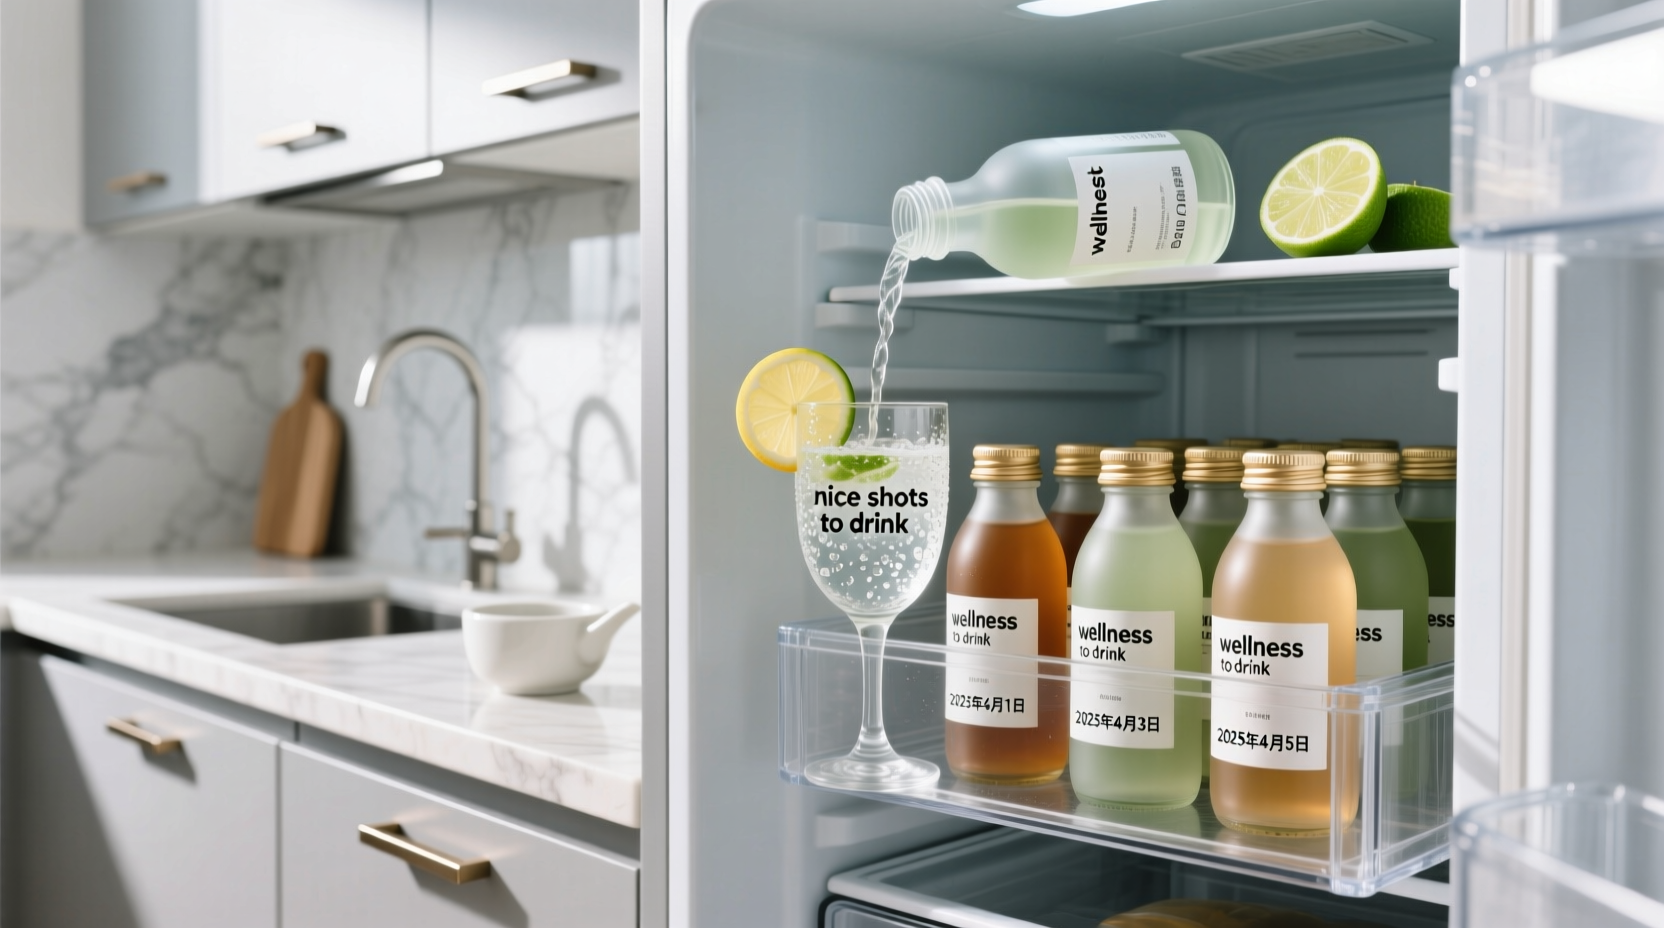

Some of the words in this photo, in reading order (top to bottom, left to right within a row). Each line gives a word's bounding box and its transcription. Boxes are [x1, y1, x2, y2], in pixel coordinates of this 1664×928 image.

[814, 484, 861, 508] nice
[867, 485, 929, 508] shots
[820, 513, 844, 533] to
[849, 511, 909, 534] drink
[951, 609, 1018, 631] wellness
[962, 631, 991, 647] drink
[1078, 621, 1153, 645] wellness
[1079, 645, 1090, 658] to
[1092, 644, 1126, 662] drink
[1219, 634, 1304, 658] wellness
[1220, 658, 1233, 673] to
[1234, 657, 1271, 677] drink
[1075, 709, 1160, 733] 2025年4月3日
[1217, 727, 1309, 753] 2025年4月5日
